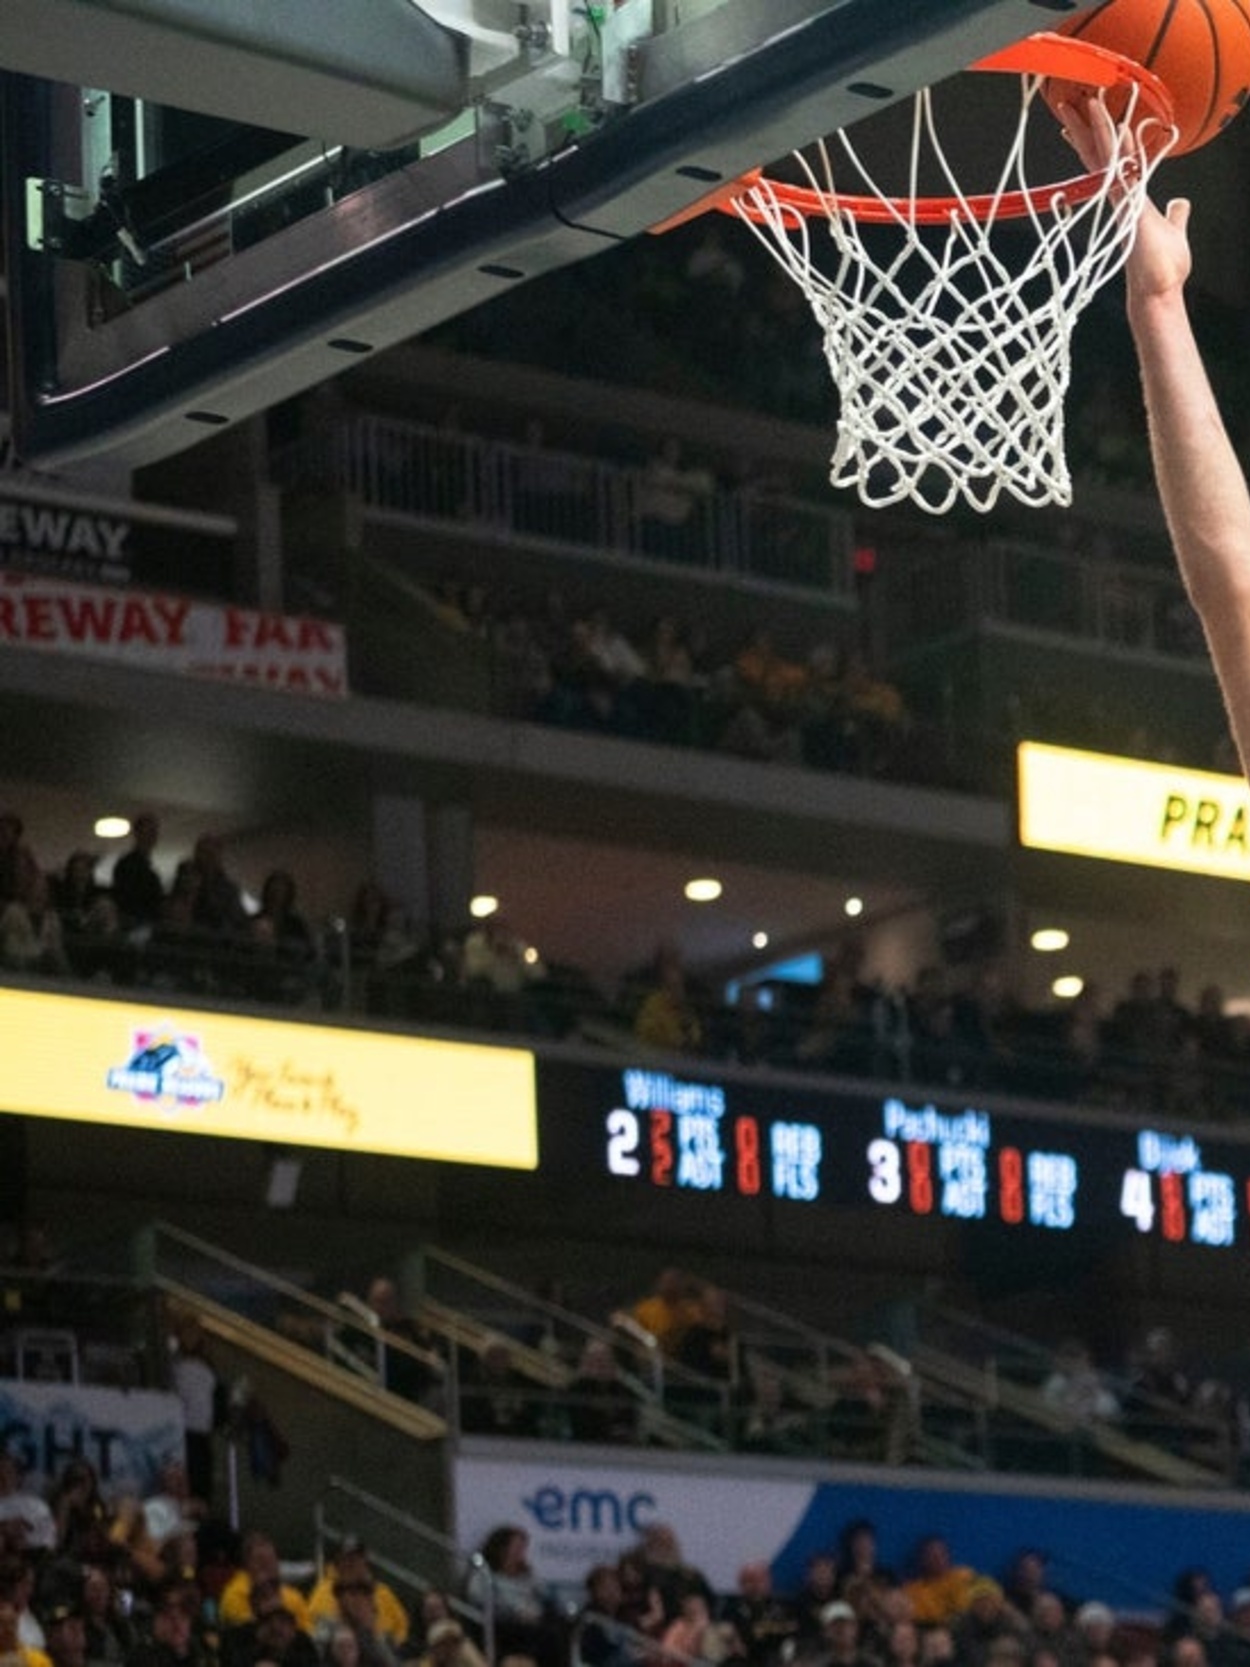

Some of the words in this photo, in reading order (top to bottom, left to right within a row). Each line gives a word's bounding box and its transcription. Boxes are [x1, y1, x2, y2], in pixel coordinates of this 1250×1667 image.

[607, 1109, 640, 1175] 2
[867, 1139, 901, 1204] 3
[1121, 1169, 1154, 1232] 4
[522, 1483, 656, 1533] emc
